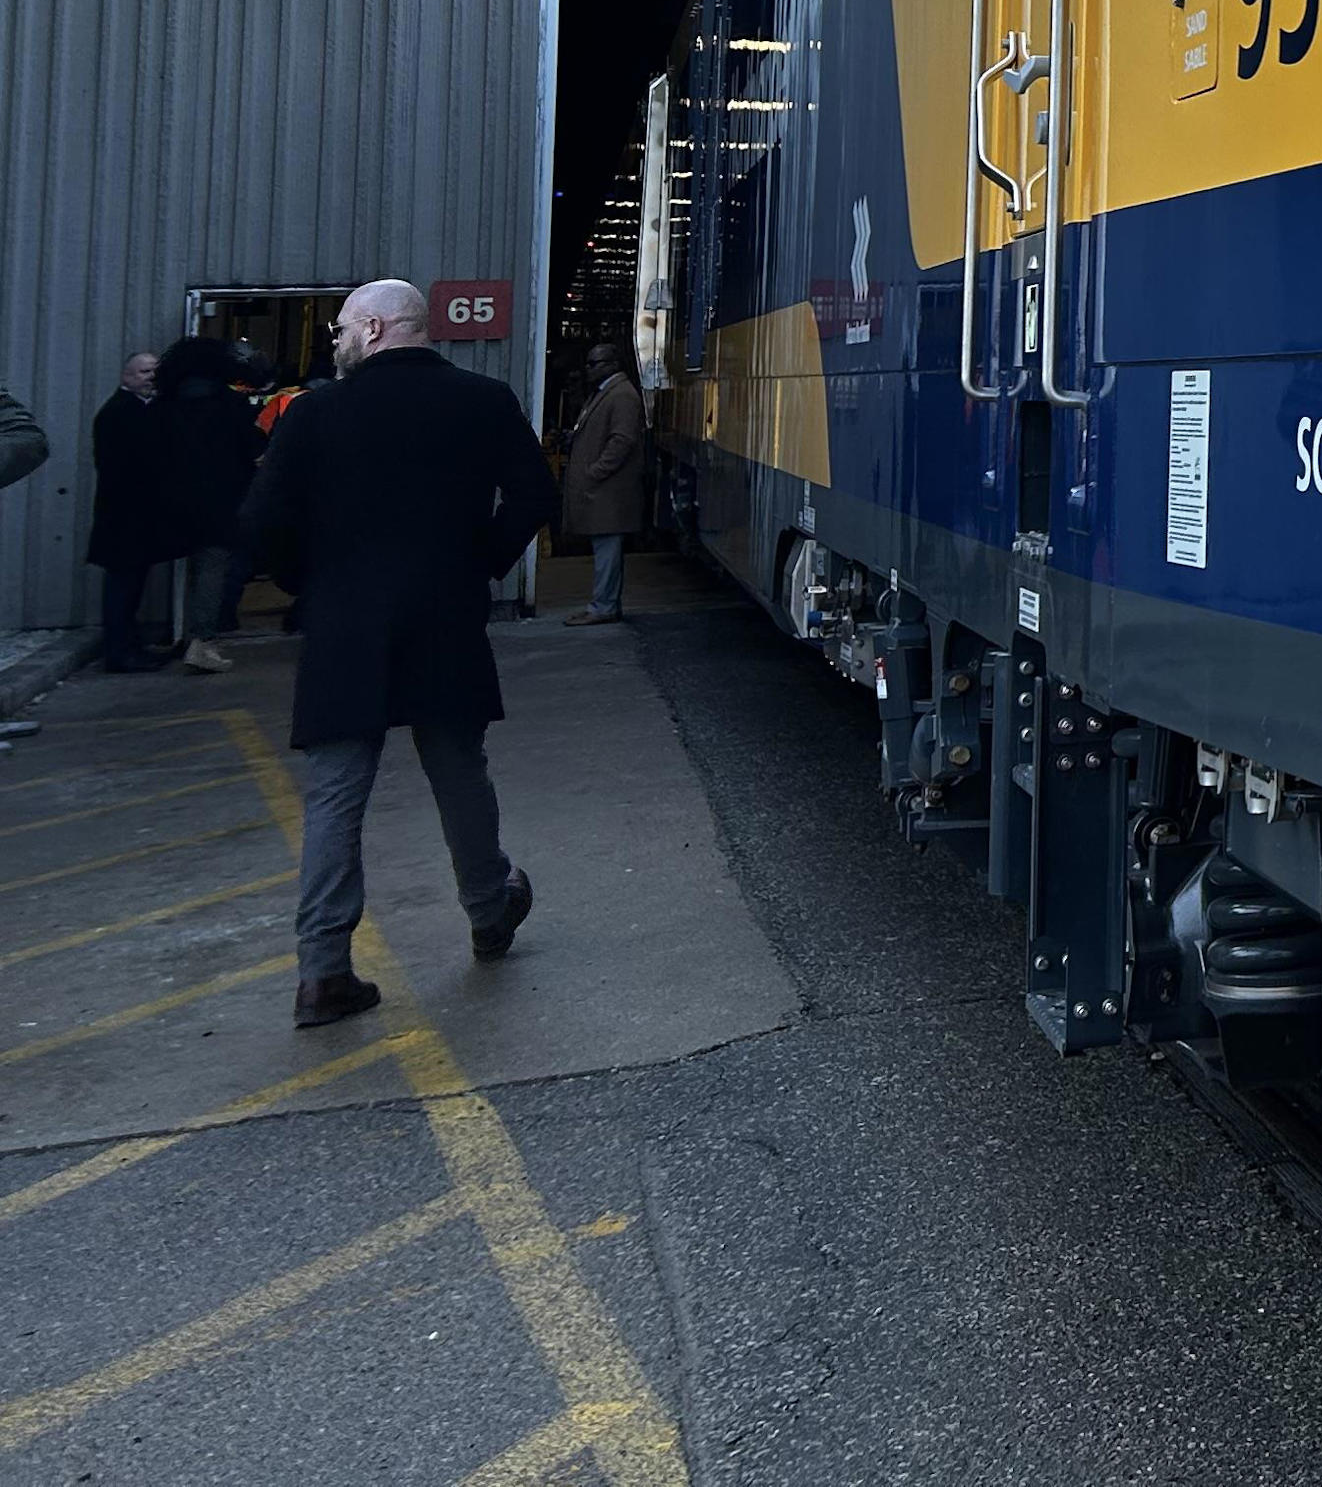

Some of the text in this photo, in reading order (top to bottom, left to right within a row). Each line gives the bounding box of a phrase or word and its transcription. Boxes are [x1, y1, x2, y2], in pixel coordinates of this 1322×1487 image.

[1185, 9, 1208, 38] SAND
[1184, 43, 1208, 73] SABLE
[447, 297, 495, 324] 65
